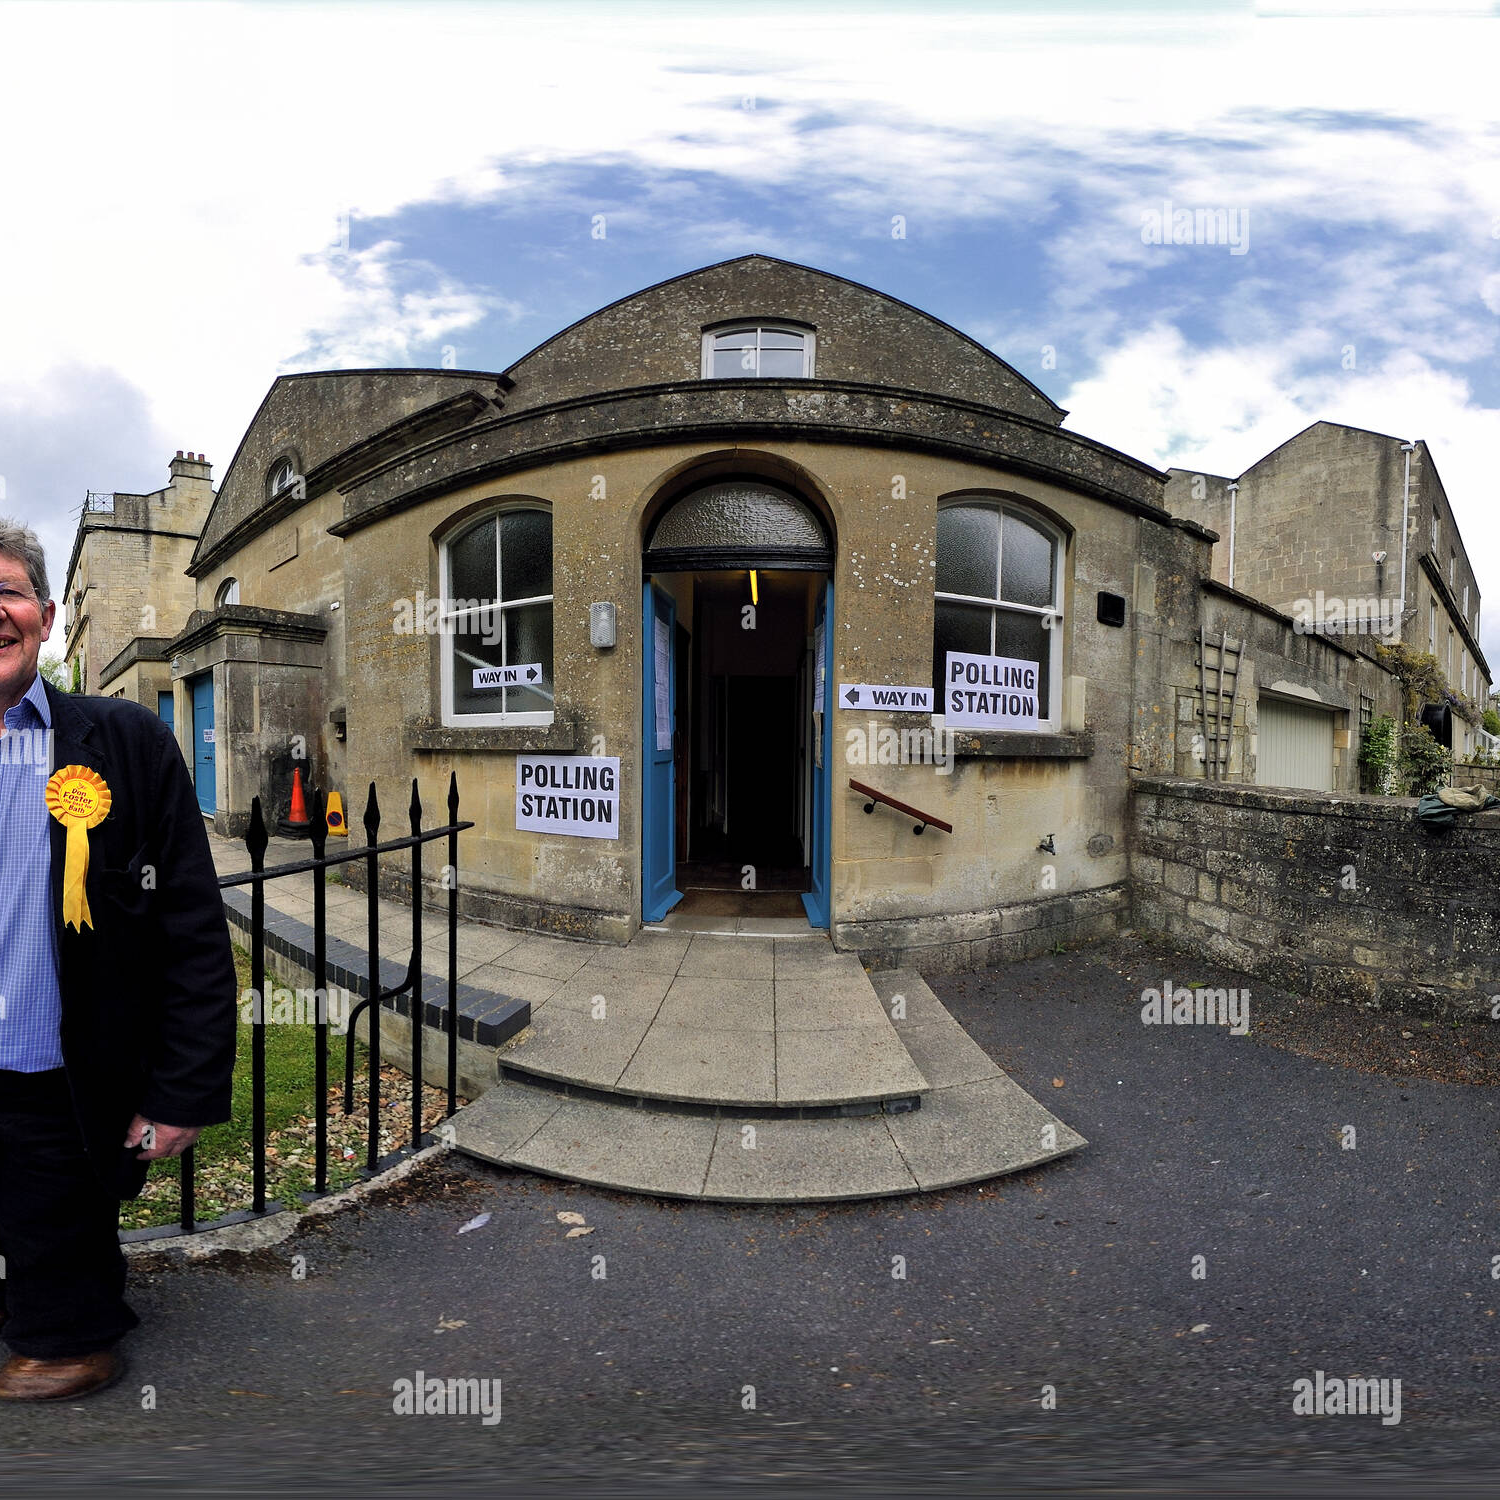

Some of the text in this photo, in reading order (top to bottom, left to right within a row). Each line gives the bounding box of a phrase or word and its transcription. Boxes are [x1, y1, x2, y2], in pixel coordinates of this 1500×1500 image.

[478, 670, 517, 684] WAY IN
[950, 661, 1035, 690] POLLING
[872, 690, 927, 706] WAY IN
[951, 690, 1034, 716] STATION
[521, 764, 614, 791] POLLING
[63, 792, 93, 804] Foster
[72, 788, 86, 797] Don
[68, 805, 85, 813] Bath
[521, 794, 612, 823] STATION
